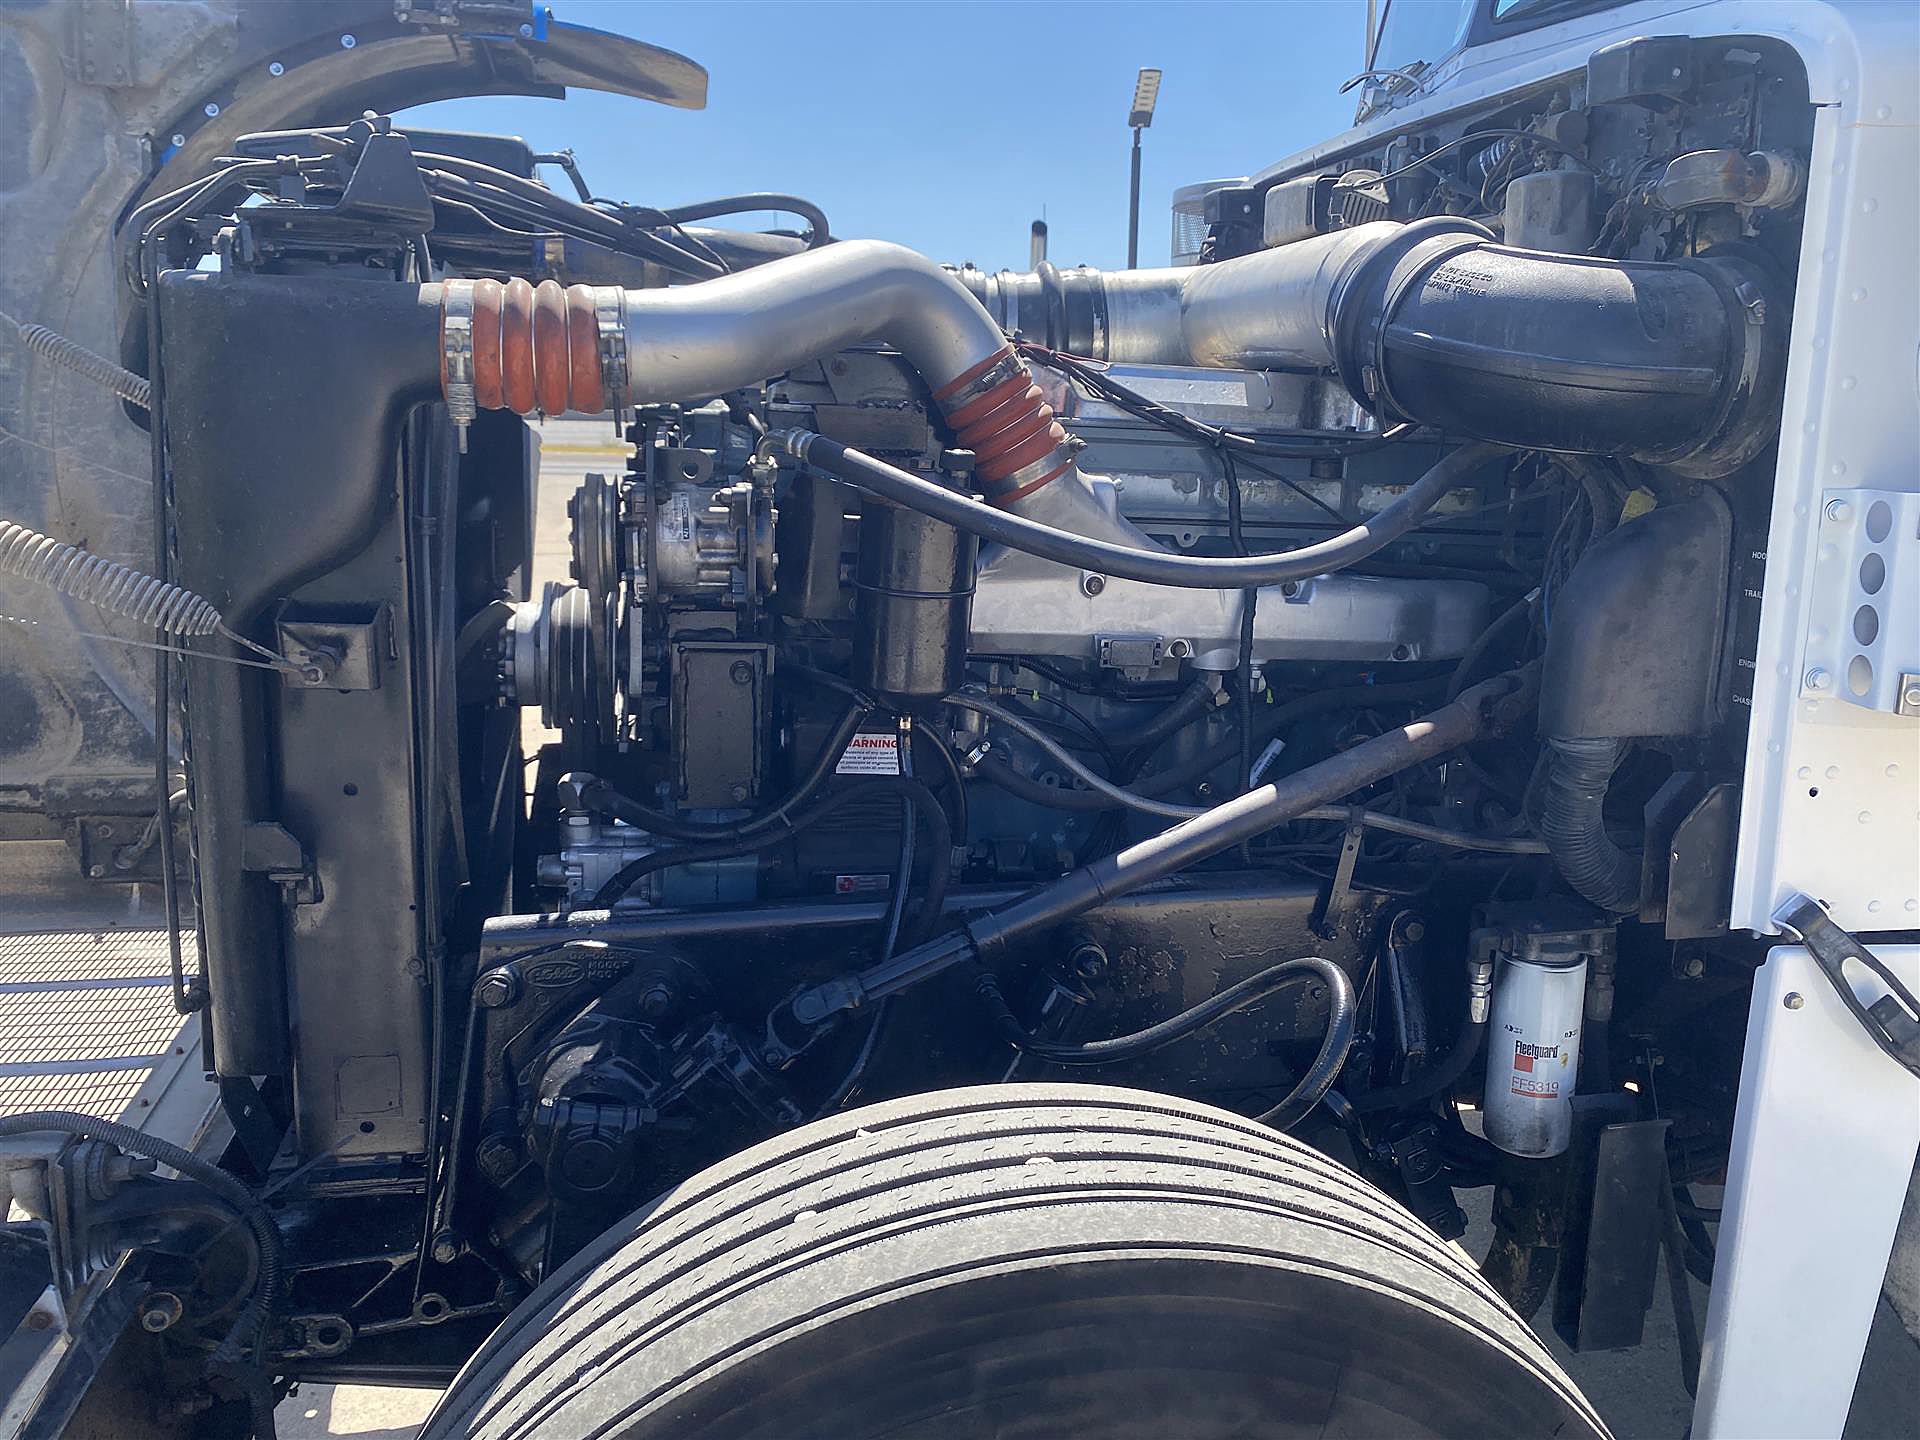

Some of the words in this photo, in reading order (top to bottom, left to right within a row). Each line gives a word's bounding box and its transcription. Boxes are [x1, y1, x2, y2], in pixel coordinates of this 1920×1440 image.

[1751, 551, 1767, 560] HOO
[1515, 1039, 1559, 1060] Fleetguard
[1511, 1076, 1559, 1093] FF5319
